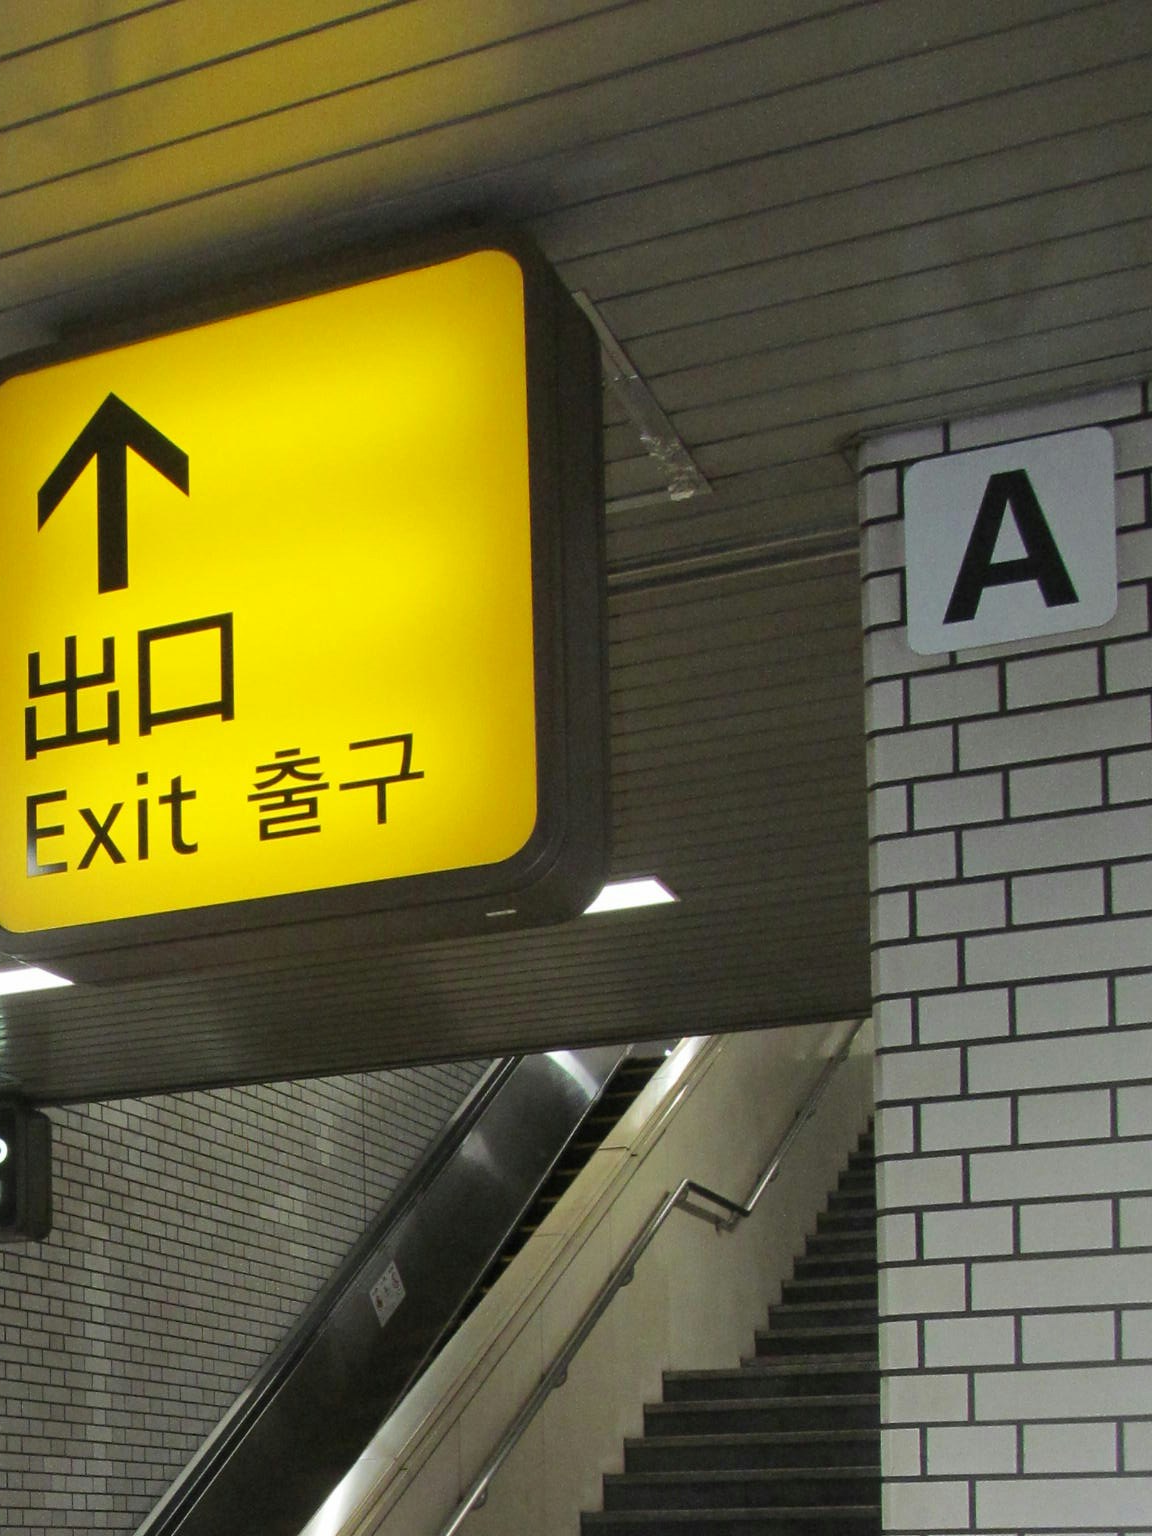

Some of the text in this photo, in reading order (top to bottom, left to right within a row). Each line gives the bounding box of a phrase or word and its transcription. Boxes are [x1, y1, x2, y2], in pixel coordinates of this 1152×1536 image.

[943, 469, 1079, 624] A
[24, 611, 235, 761] 出口
[26, 733, 425, 878] Exit 출구
